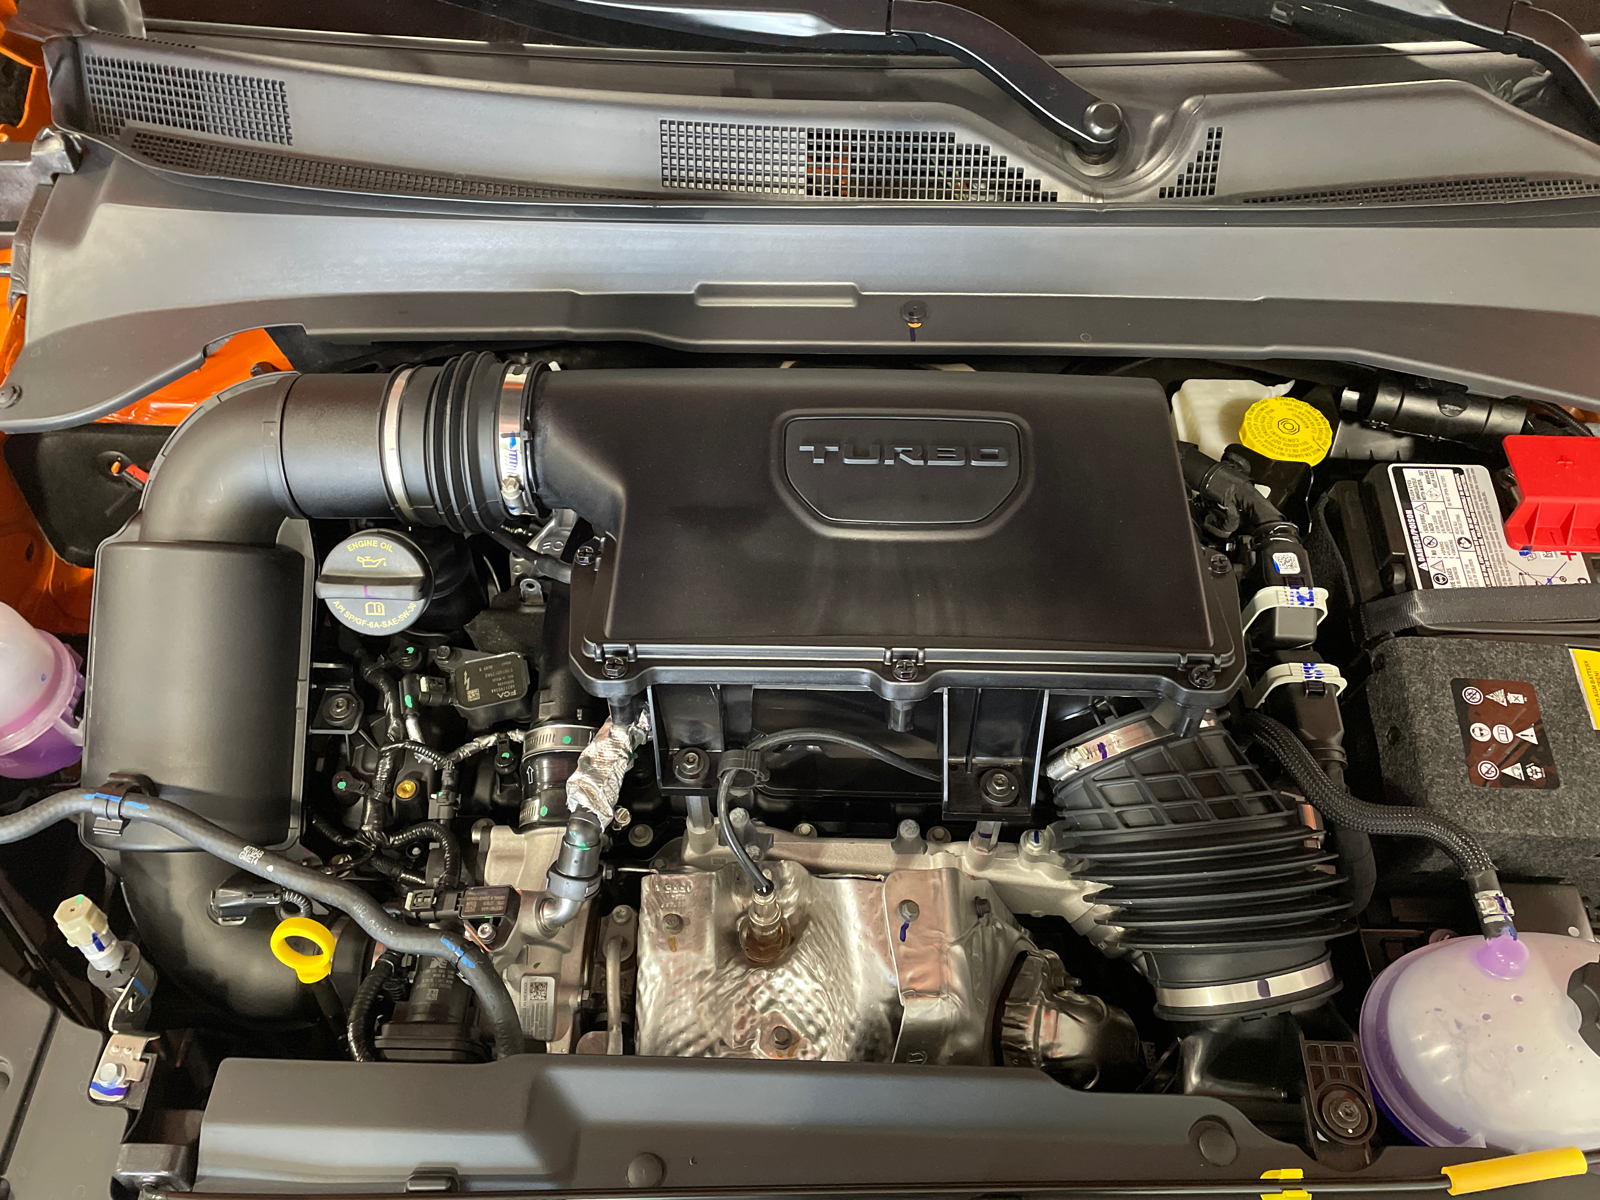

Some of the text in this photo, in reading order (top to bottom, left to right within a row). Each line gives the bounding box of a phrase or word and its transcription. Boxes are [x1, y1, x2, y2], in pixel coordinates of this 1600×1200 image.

[799, 442, 1010, 466] TURBO
[1405, 510, 1426, 562] DANGER/POISON
[347, 540, 393, 552] ENGINE OIL
[332, 600, 346, 613] API
[1583, 660, 1596, 685] BATTERY
[497, 689, 517, 698] FCA
